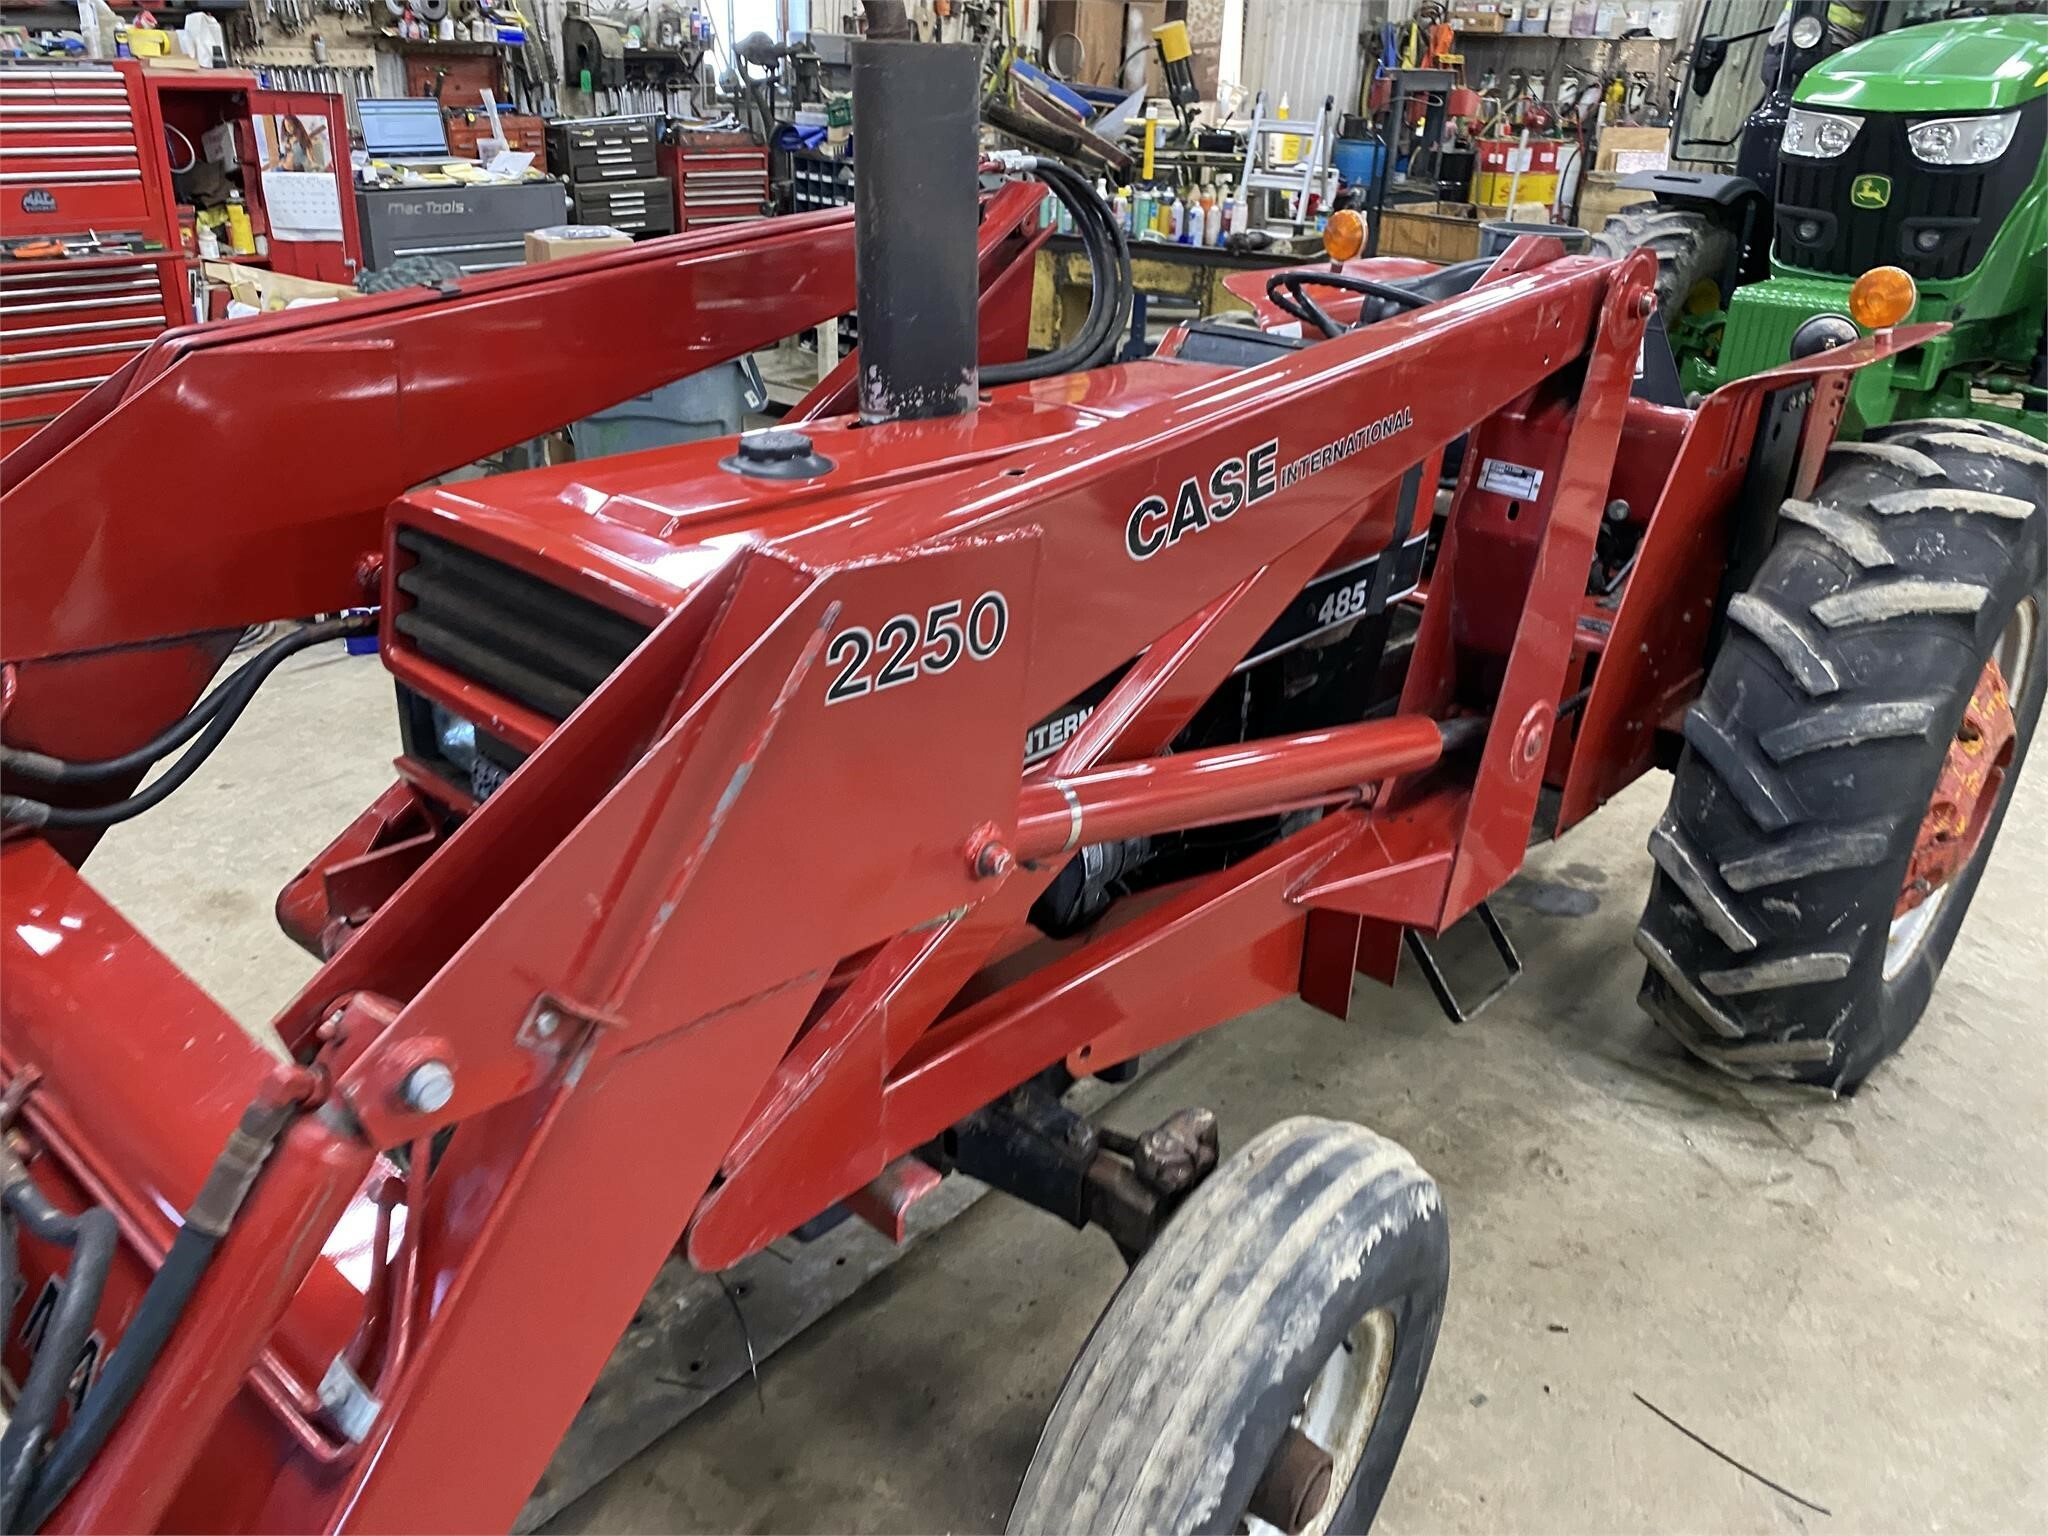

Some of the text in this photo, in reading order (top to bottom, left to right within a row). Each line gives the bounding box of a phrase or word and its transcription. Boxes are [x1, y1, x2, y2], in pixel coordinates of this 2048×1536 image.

[425, 200, 464, 214] Tools
[1126, 406, 1413, 561] CASE INTERNATIONAL
[1318, 579, 1367, 625] 485
[824, 590, 1009, 707] 2250
